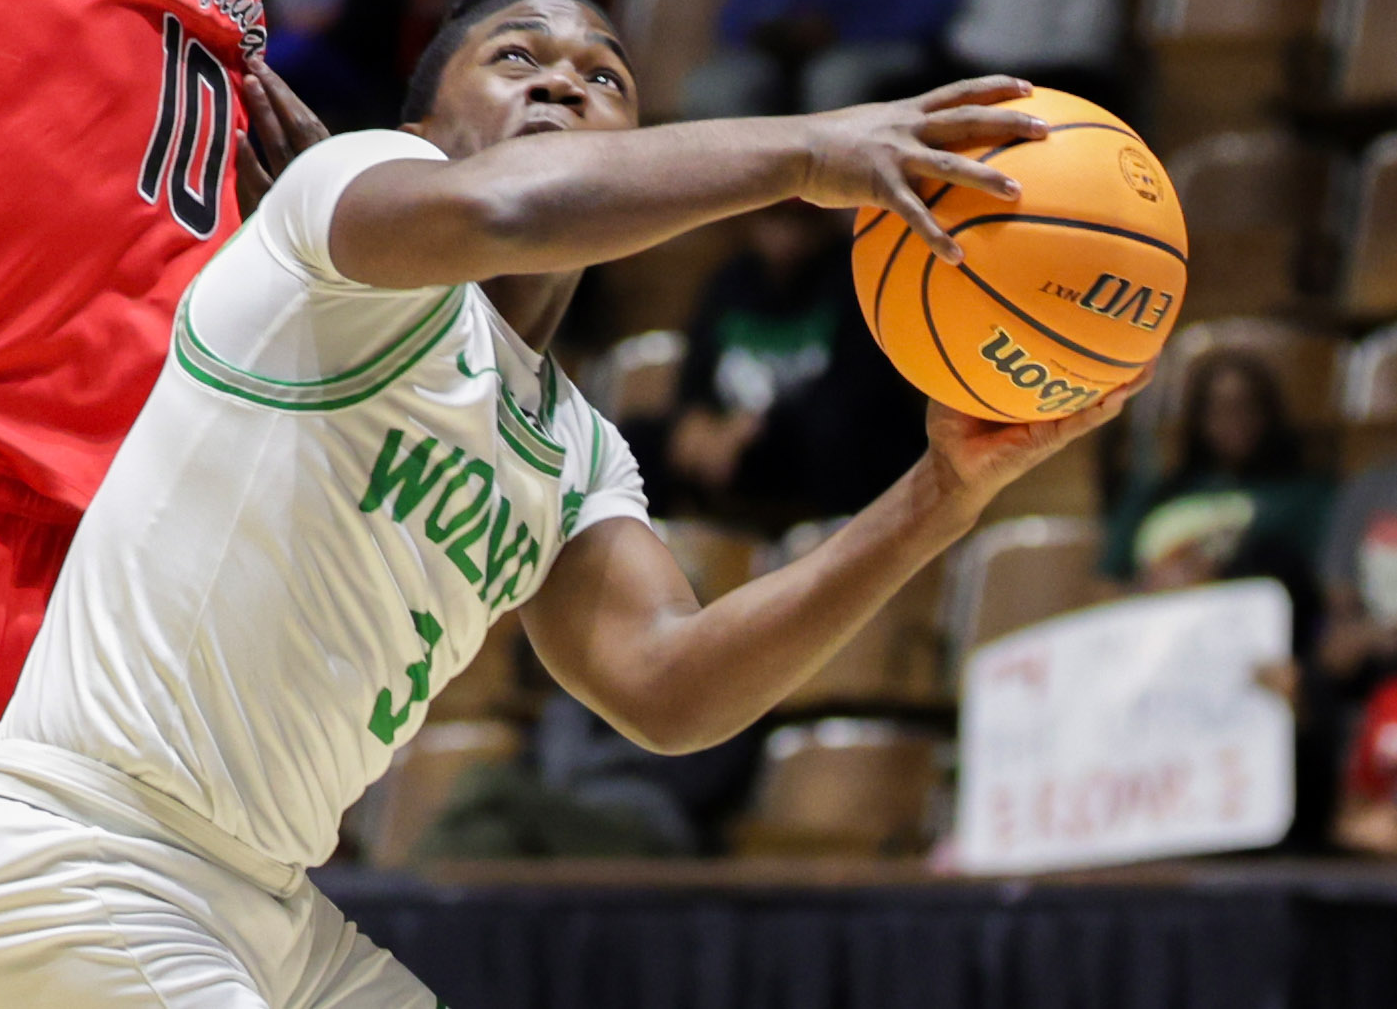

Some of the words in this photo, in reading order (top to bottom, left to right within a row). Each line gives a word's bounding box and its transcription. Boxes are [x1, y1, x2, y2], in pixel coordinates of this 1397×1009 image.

[137, 11, 233, 241] 10
[1038, 280, 1080, 303] NXT
[1077, 272, 1173, 332] EVO
[978, 324, 1102, 415] ilson
[367, 608, 444, 747] 3
